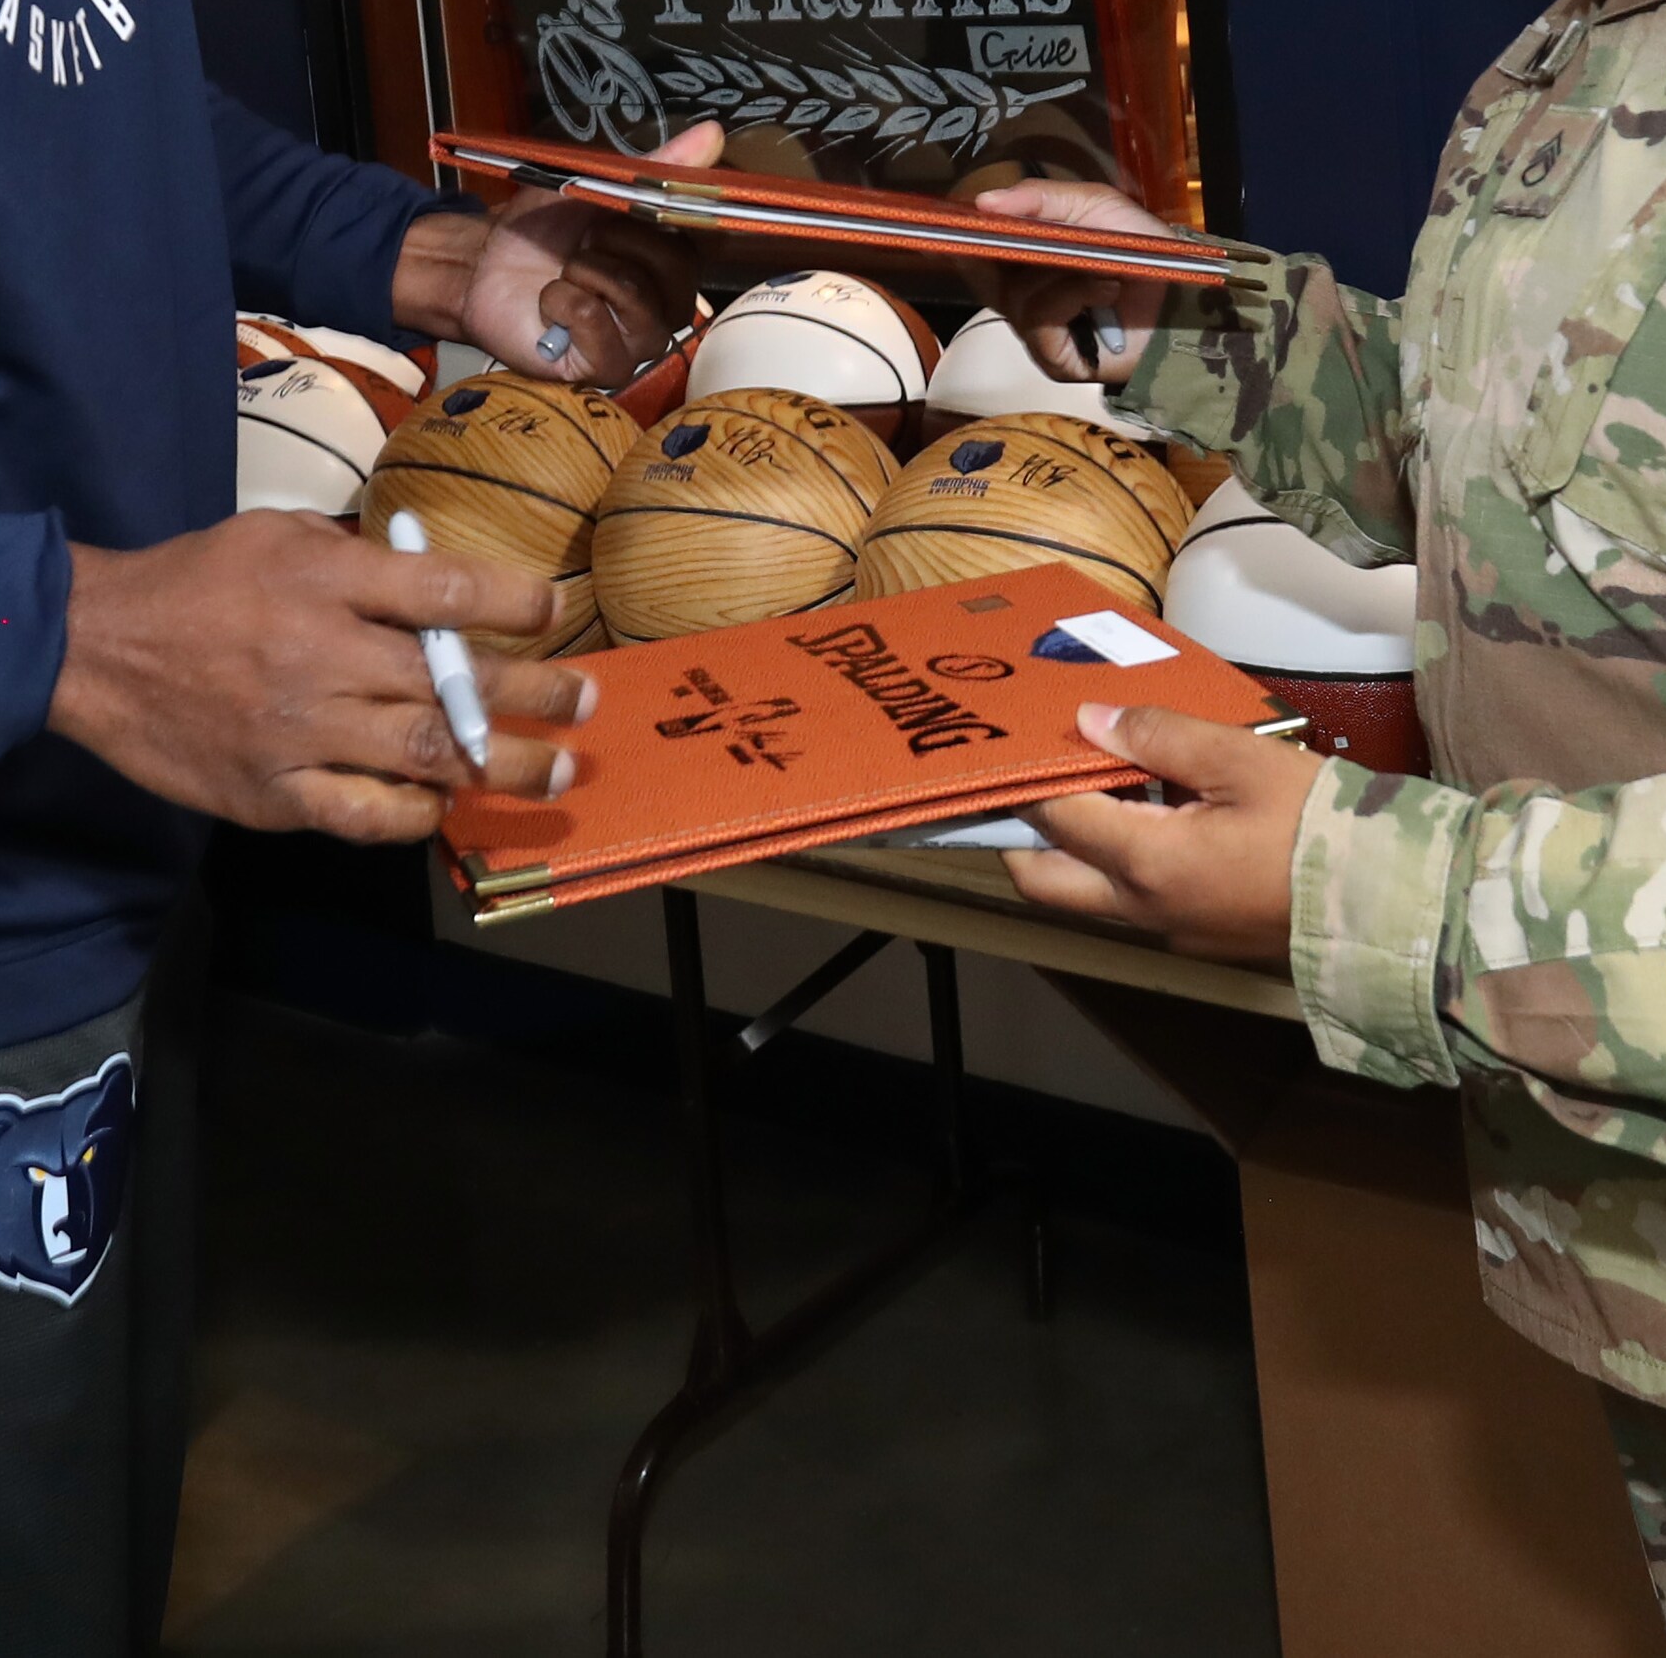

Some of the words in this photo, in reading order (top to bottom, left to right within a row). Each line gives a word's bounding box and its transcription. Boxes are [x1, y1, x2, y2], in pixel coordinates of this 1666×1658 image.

[979, 31, 1077, 69] Give
[931, 477, 991, 490] MEMPHIS
[784, 623, 1010, 757] SPALDING
